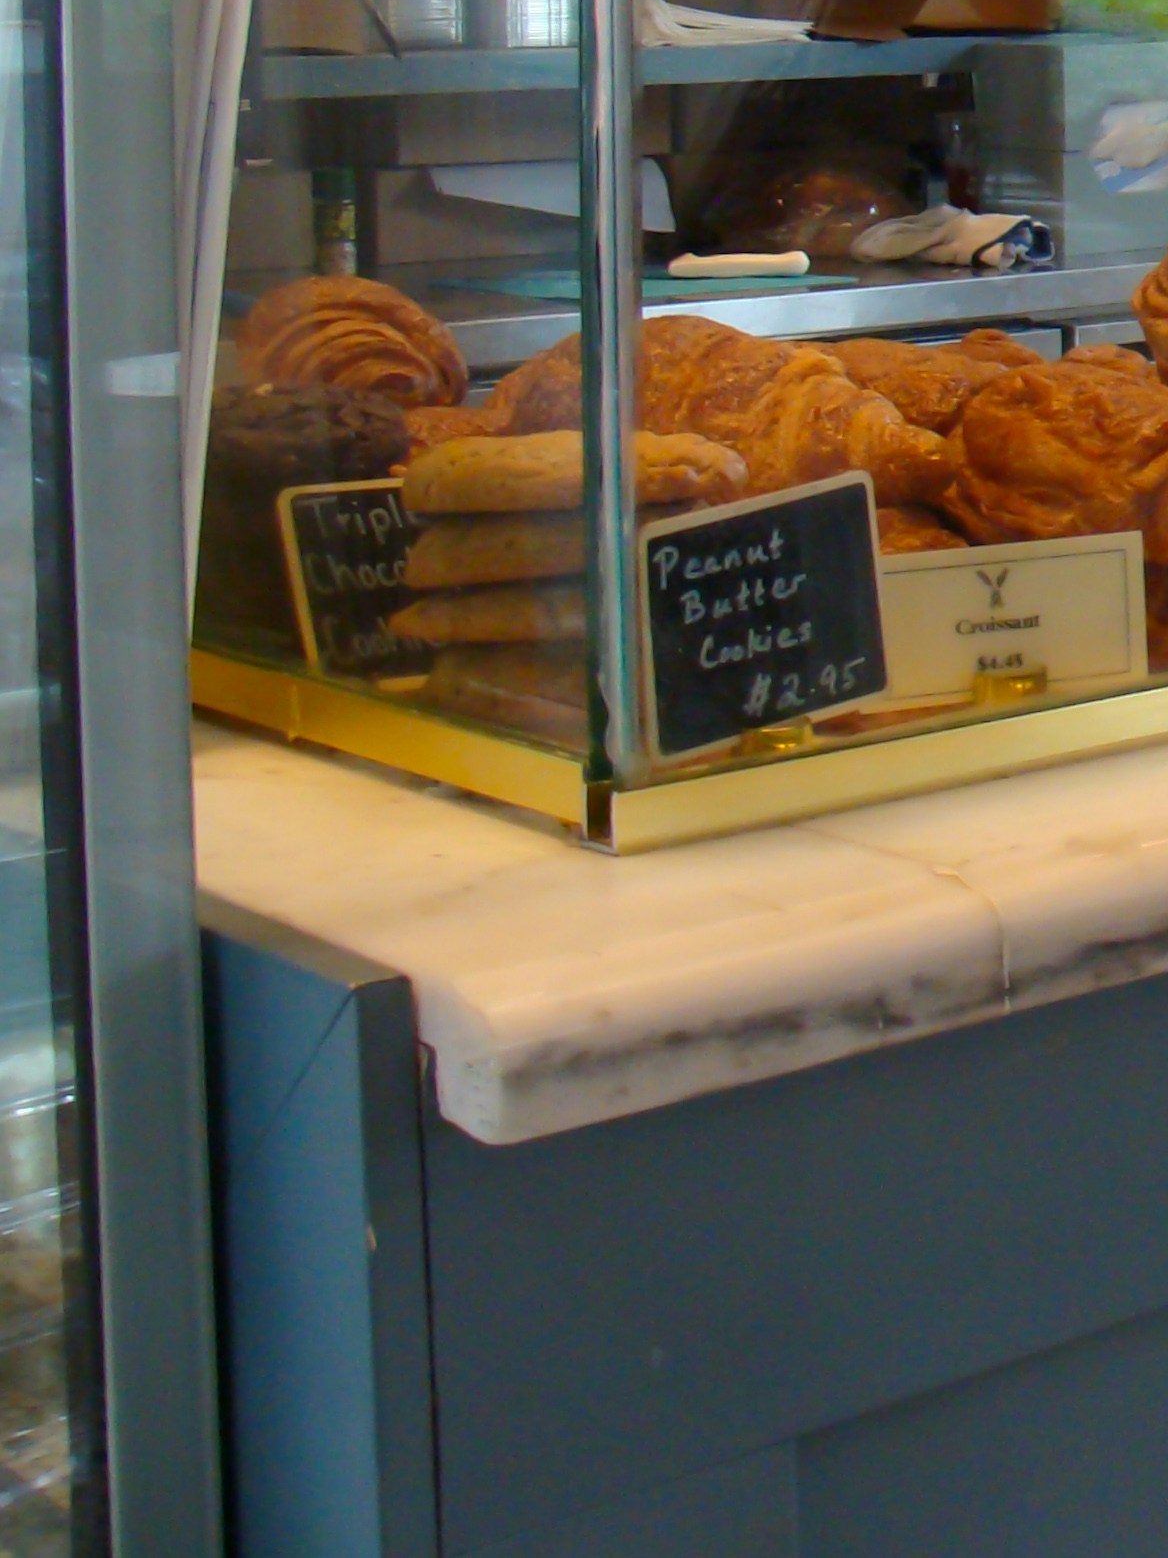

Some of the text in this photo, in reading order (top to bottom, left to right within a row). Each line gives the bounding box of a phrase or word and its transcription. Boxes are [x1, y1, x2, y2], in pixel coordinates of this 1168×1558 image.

[652, 528, 786, 591] Peanut
[680, 573, 807, 625] Butter
[700, 621, 812, 670] Cookies
[954, 615, 1040, 636] Croissant
[742, 656, 867, 718] $2.95
